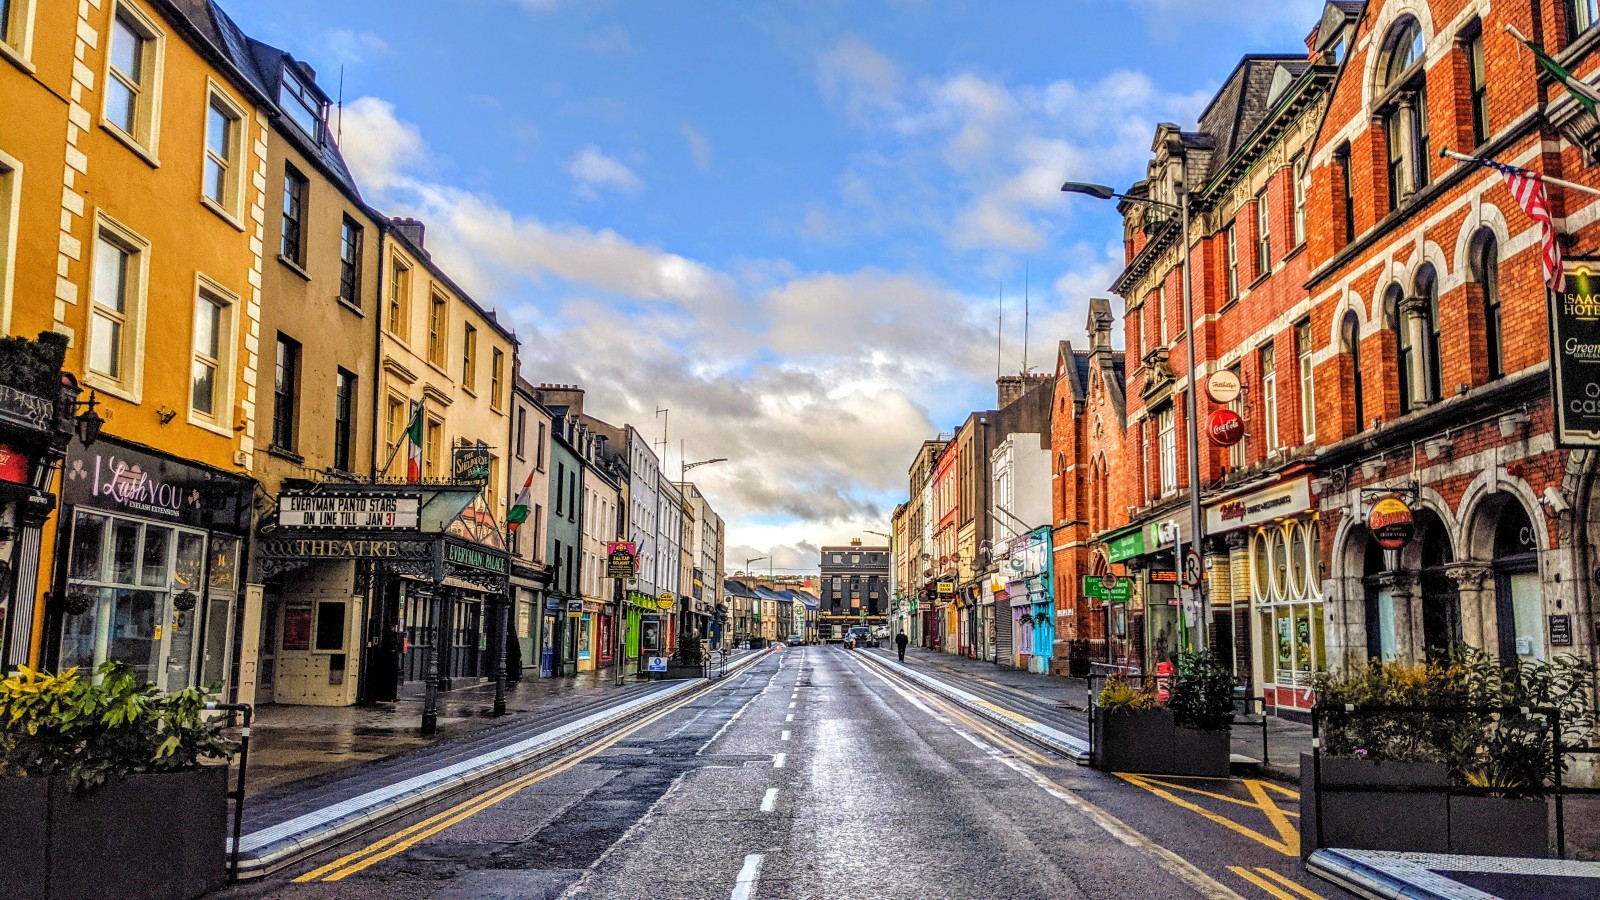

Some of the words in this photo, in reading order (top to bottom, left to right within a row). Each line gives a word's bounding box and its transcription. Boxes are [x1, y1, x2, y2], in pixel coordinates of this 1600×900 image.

[103, 456, 147, 502] Lash
[149, 480, 183, 509] YOU
[129, 500, 151, 511] EYELASH
[151, 505, 180, 517] EXTENSIONS
[291, 498, 334, 511] EVERYMAN
[338, 498, 366, 511] PANTO
[369, 499, 397, 511] STARS
[303, 512, 315, 525] ON
[320, 512, 337, 525] LINE
[341, 512, 357, 526] TILL
[366, 512, 384, 526] JAN
[385, 512, 396, 526] 31
[298, 540, 398, 556] THEATRE
[449, 544, 483, 567] EVERYMAN
